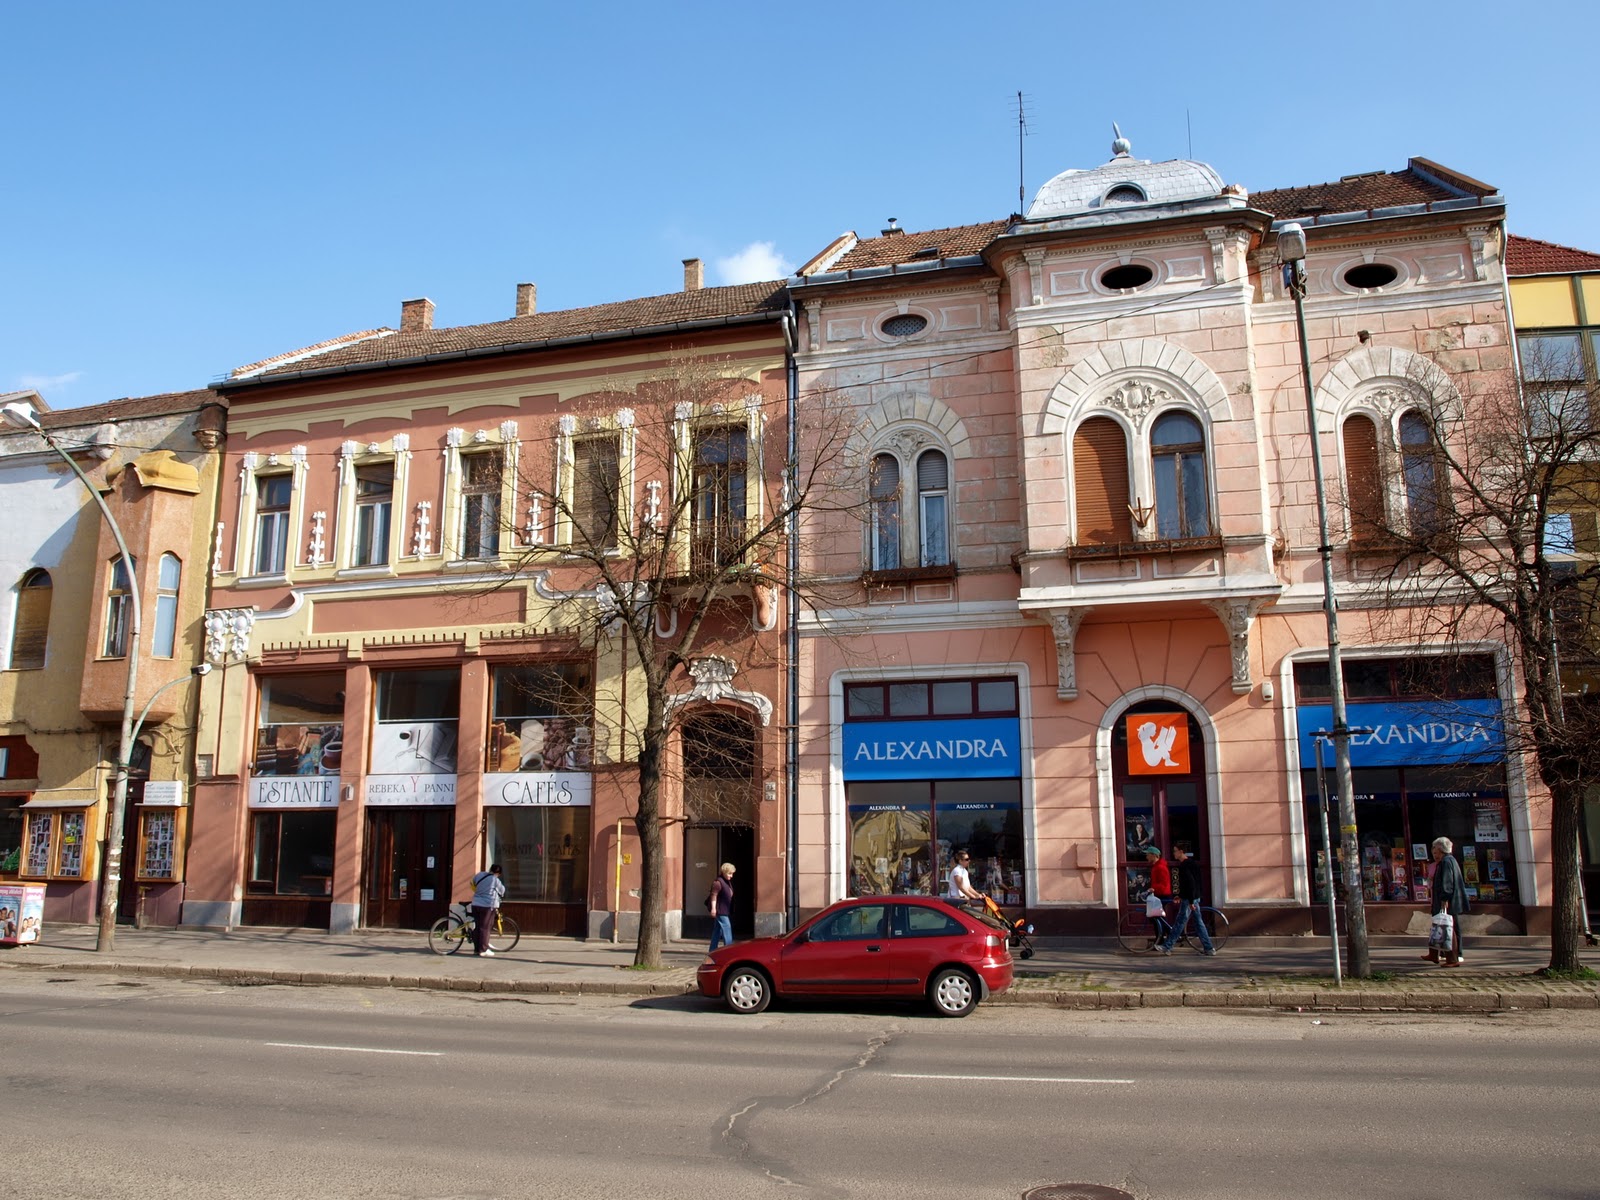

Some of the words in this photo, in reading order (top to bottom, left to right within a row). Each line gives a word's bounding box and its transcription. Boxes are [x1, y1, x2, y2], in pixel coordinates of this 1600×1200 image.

[1313, 721, 1490, 747] AEXANDRA
[854, 738, 1008, 761] ALEXANDRA
[258, 780, 333, 804] ESTANTE
[369, 784, 406, 793] REBEKA
[410, 775, 420, 793] Y
[424, 783, 454, 793] PANNI
[502, 773, 573, 805] CAFÉS
